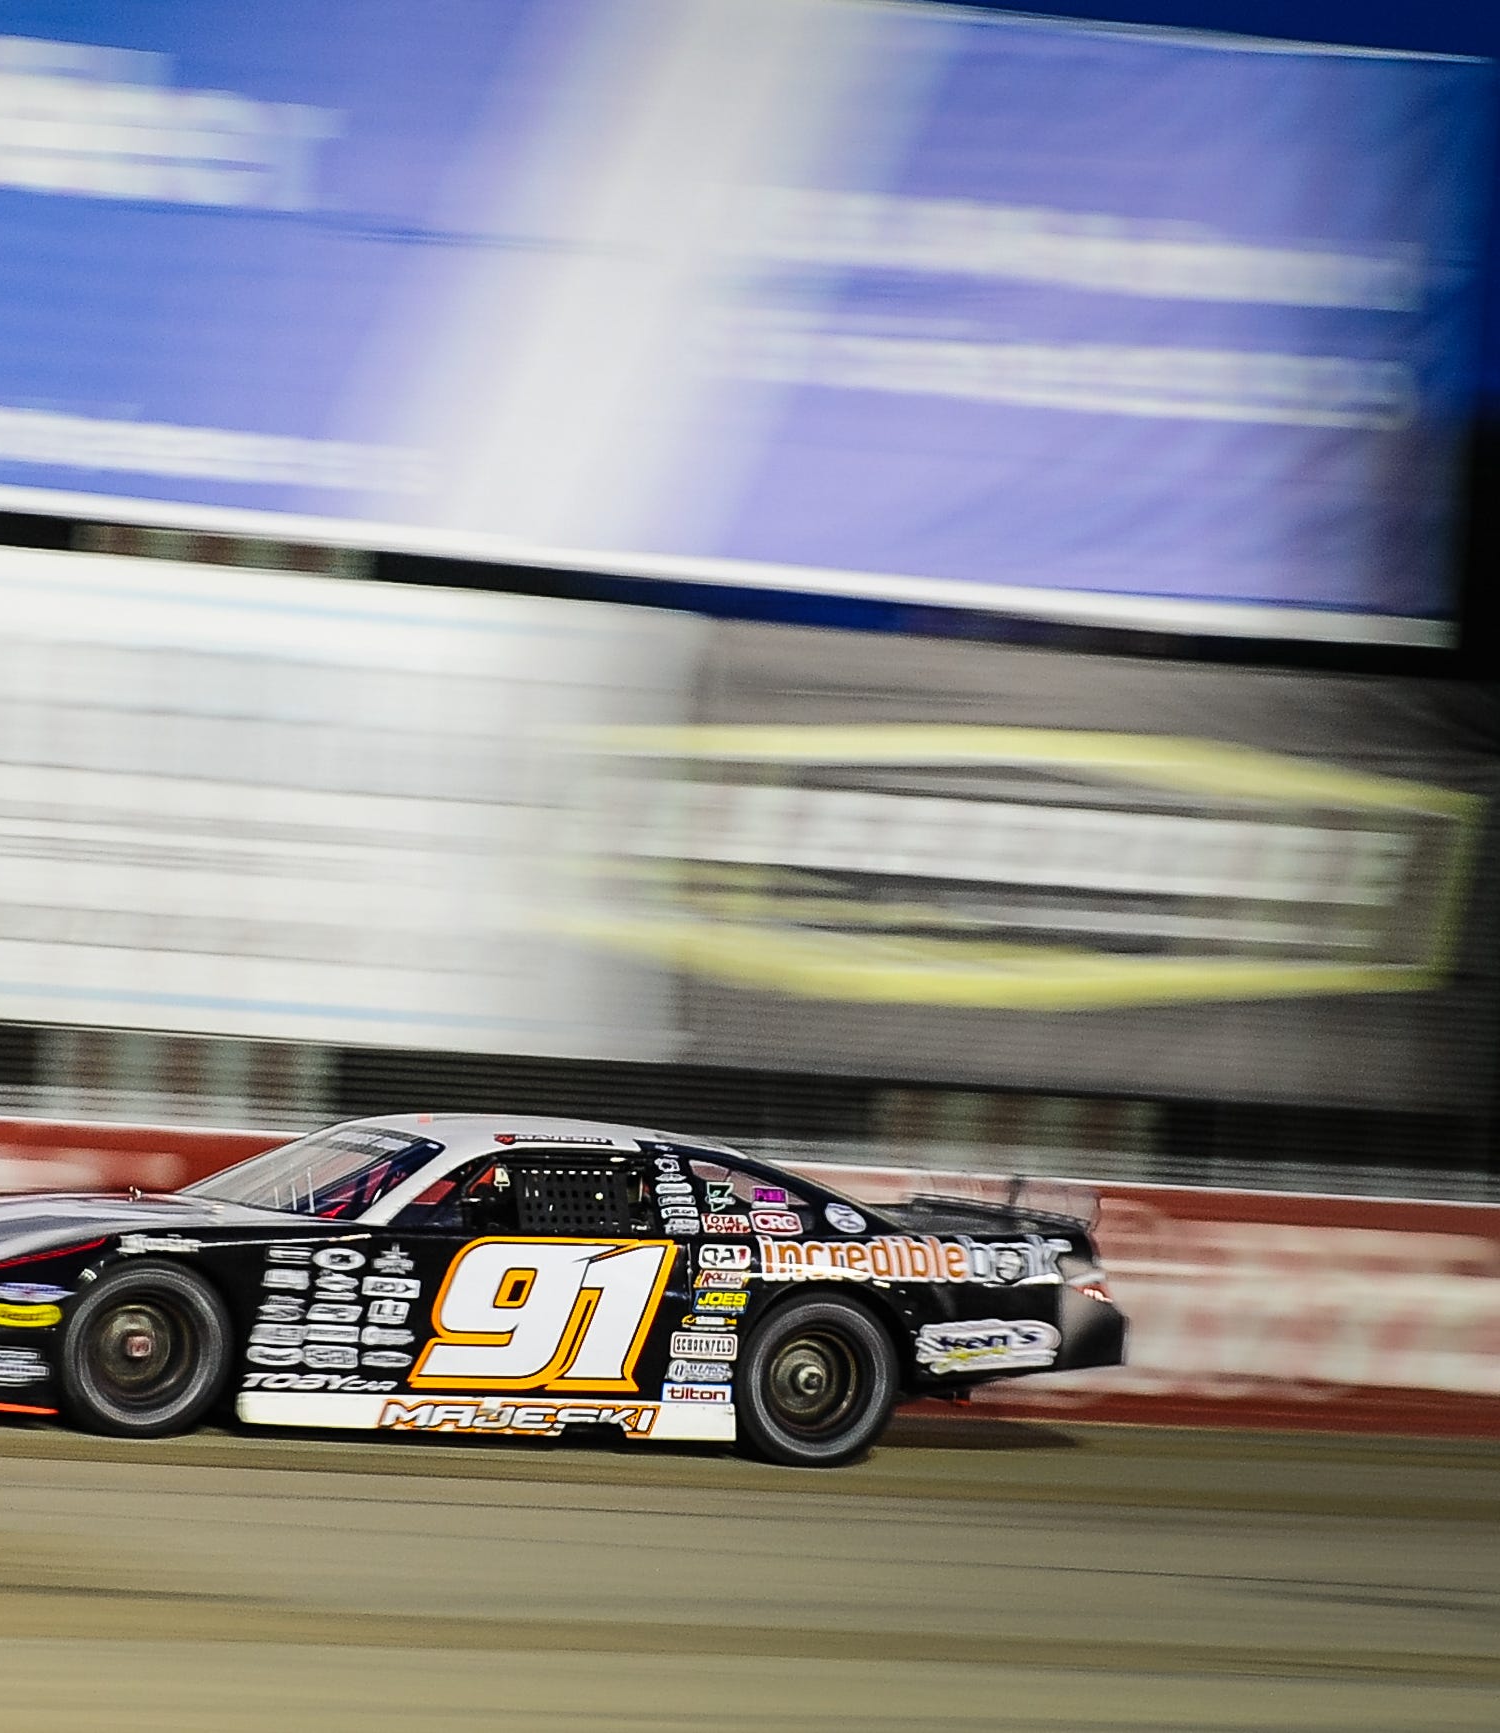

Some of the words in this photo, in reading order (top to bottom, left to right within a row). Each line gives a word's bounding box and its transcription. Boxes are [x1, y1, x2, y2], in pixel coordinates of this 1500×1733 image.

[702, 1213, 744, 1225] TOTAL
[754, 1214, 799, 1230] CRC
[701, 1247, 748, 1266] QA1
[698, 1292, 747, 1306] JOES
[408, 1236, 676, 1392] 91
[676, 1338, 732, 1353] SCHOENFELD
[667, 1386, 727, 1401] tilton
